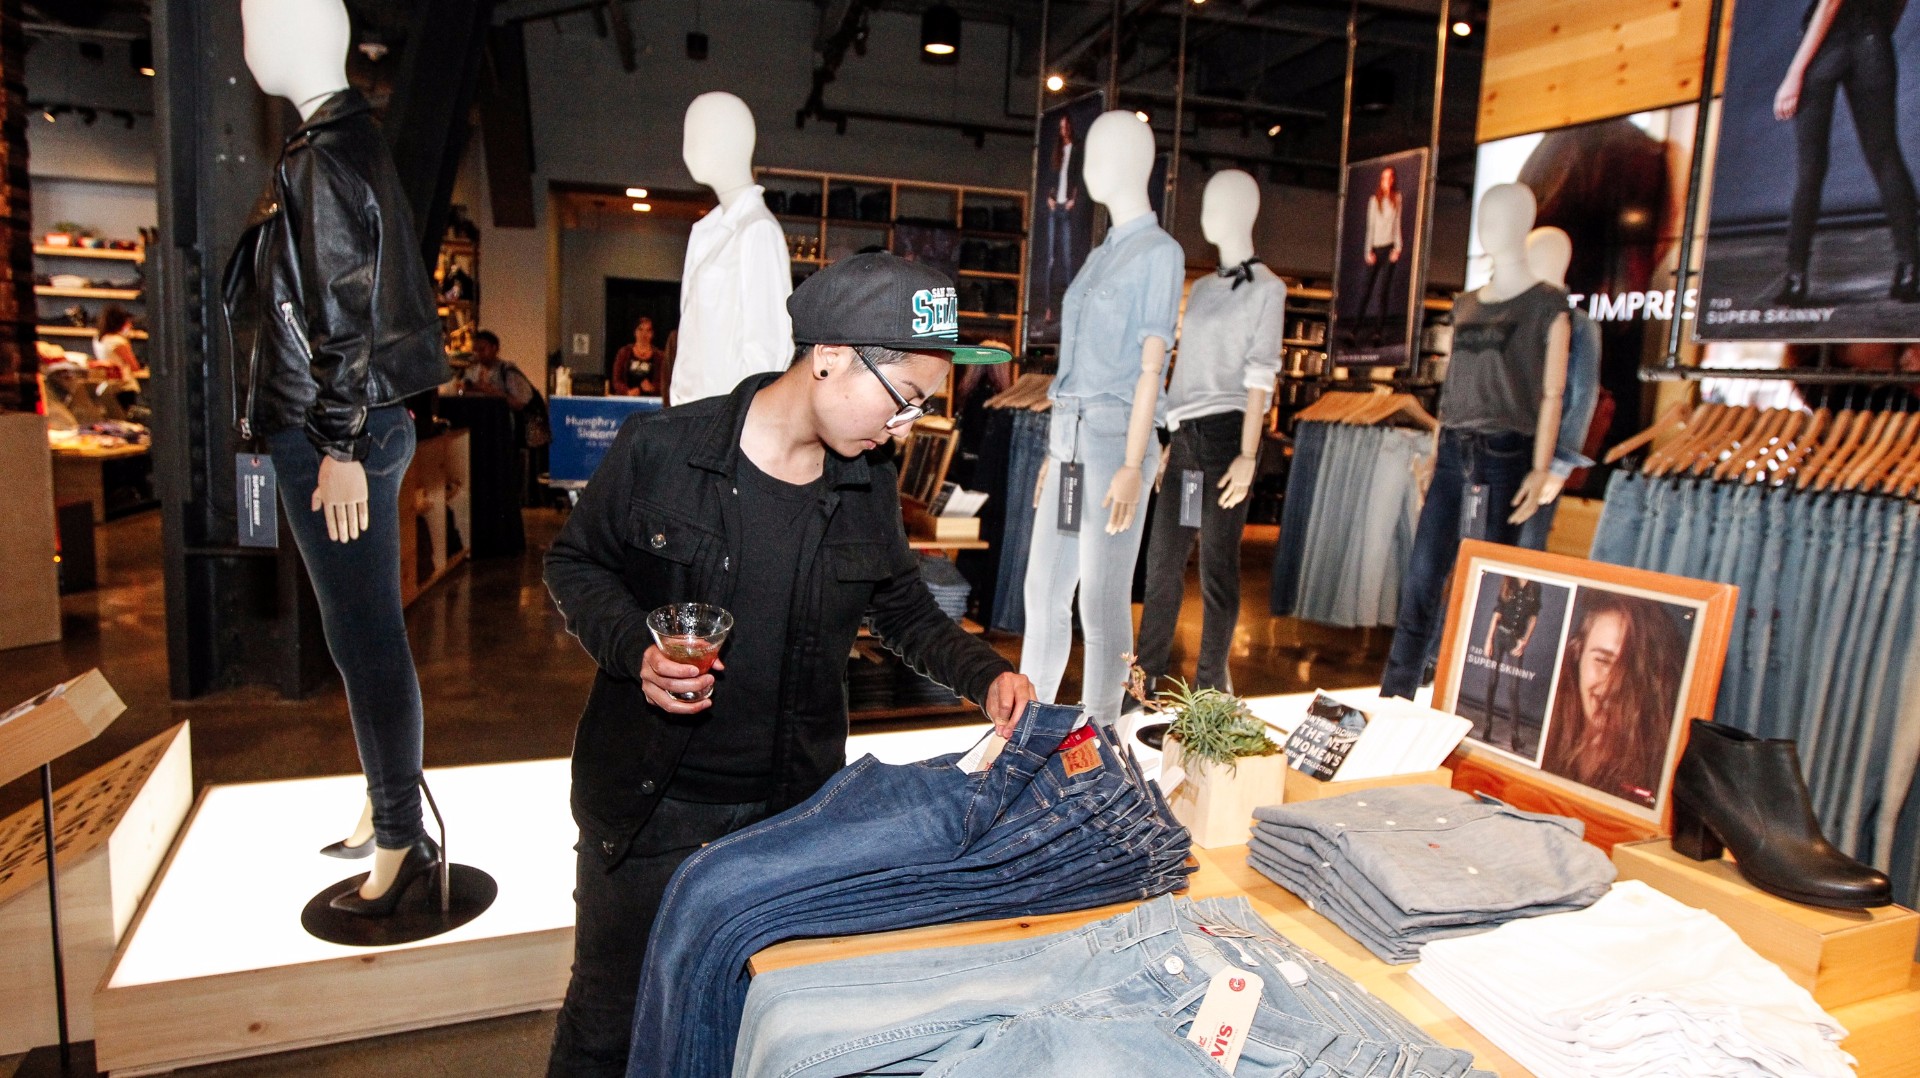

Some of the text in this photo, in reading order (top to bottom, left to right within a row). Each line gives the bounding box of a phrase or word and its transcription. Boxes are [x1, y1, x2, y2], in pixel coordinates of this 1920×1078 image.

[1706, 308, 1834, 323] SUPER SKINNY
[565, 415, 616, 429] Humphry
[1468, 654, 1536, 680] SUPER SKINNY
[1290, 736, 1342, 767] WOMEN'S
[1299, 724, 1351, 753] THE NEW
[1303, 758, 1334, 776] COLLECTION
[1210, 1024, 1233, 1063] VI'S
